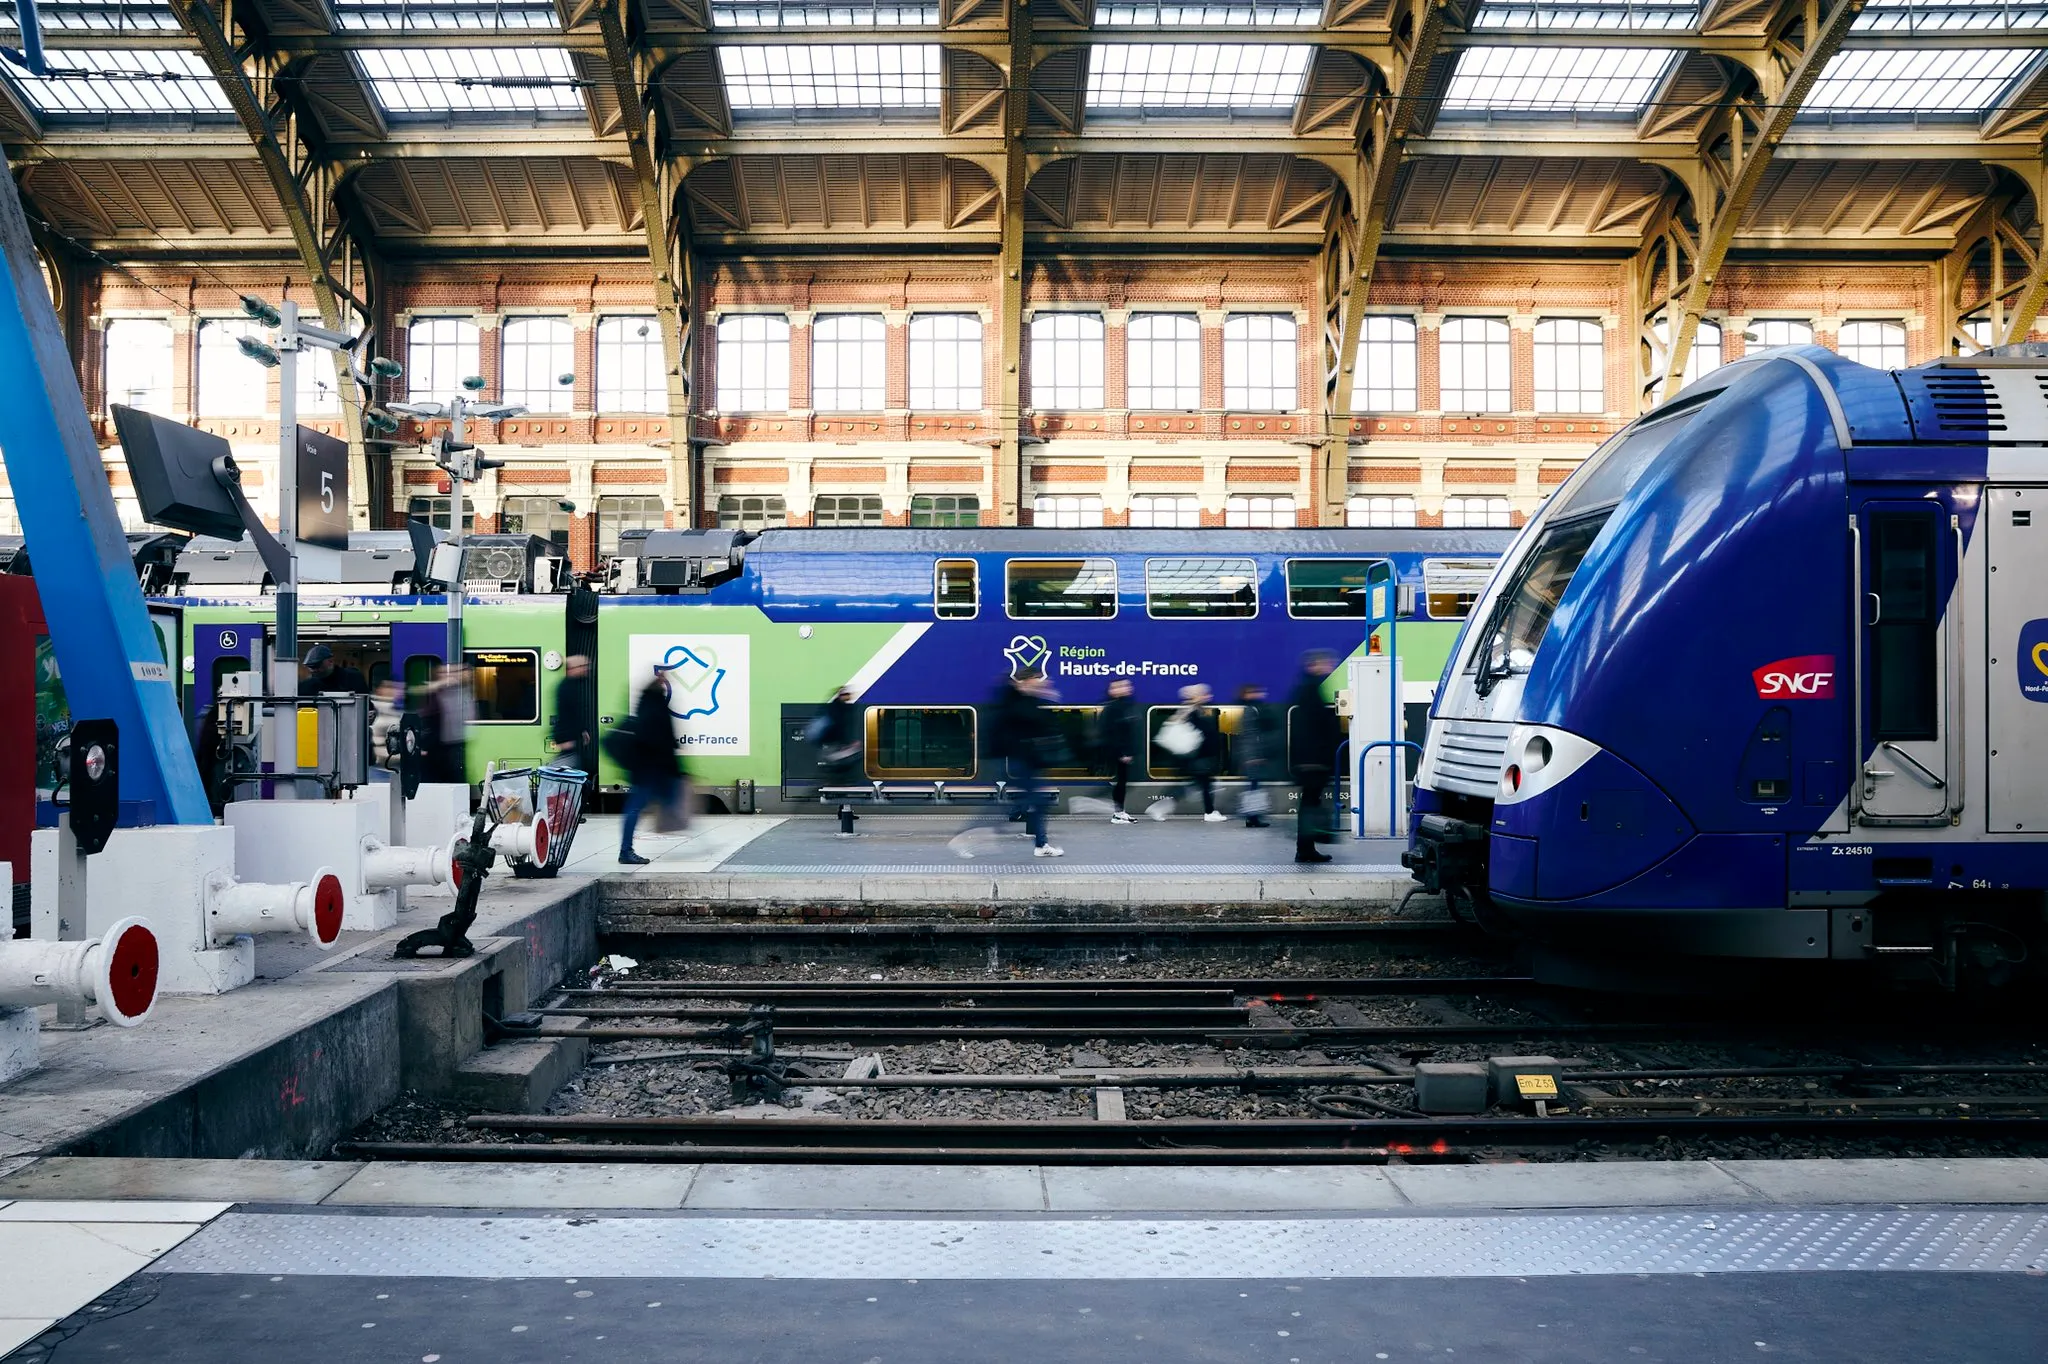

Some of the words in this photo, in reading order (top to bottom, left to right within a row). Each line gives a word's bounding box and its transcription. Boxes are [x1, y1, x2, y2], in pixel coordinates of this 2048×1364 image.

[321, 470, 334, 514] 5
[1059, 646, 1105, 660] Région
[1059, 661, 1198, 676] Hauts-de-France
[1760, 672, 1833, 694] SNCF
[675, 734, 739, 745] -de-France
[1287, 791, 1298, 800] 94
[1832, 846, 1844, 855] Zx
[1845, 846, 1873, 855] 24510
[1972, 879, 1986, 889] 64
[1518, 1078, 1534, 1088] Em
[1534, 1078, 1543, 1088] Z
[1542, 1078, 1555, 1089] 53
